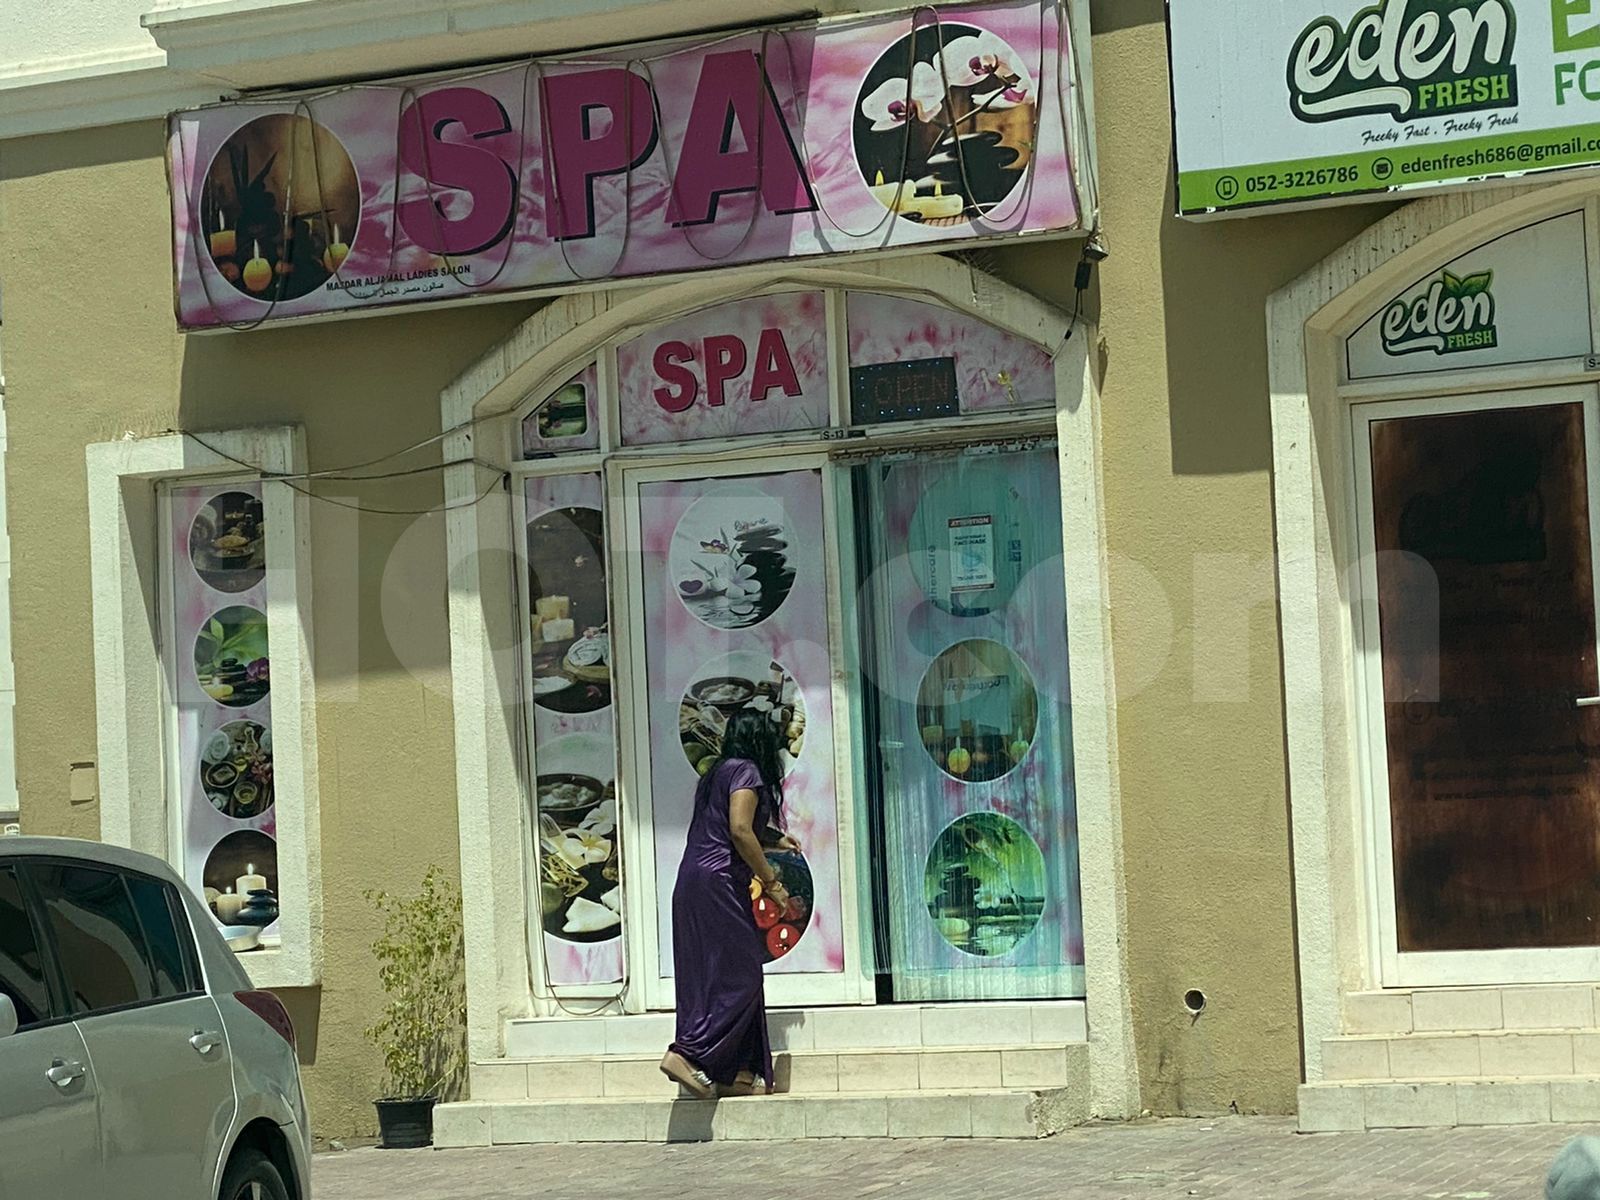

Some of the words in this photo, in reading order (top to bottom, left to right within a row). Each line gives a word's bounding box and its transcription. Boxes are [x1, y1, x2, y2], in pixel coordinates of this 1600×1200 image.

[1294, 0, 1508, 94] eden
[1418, 74, 1511, 110] FRESH
[1403, 124, 1431, 144] Fast
[1486, 112, 1519, 133] Fresh
[397, 49, 820, 257] SPA
[1245, 165, 1359, 193] 052-3226786
[407, 268, 438, 280] LADIES
[440, 264, 471, 276] SALON
[1384, 281, 1492, 341] eden
[1447, 330, 1494, 349] FRESH
[652, 327, 803, 414] SPA
[874, 371, 950, 405] OPEN
[822, 429, 845, 440] S-13
